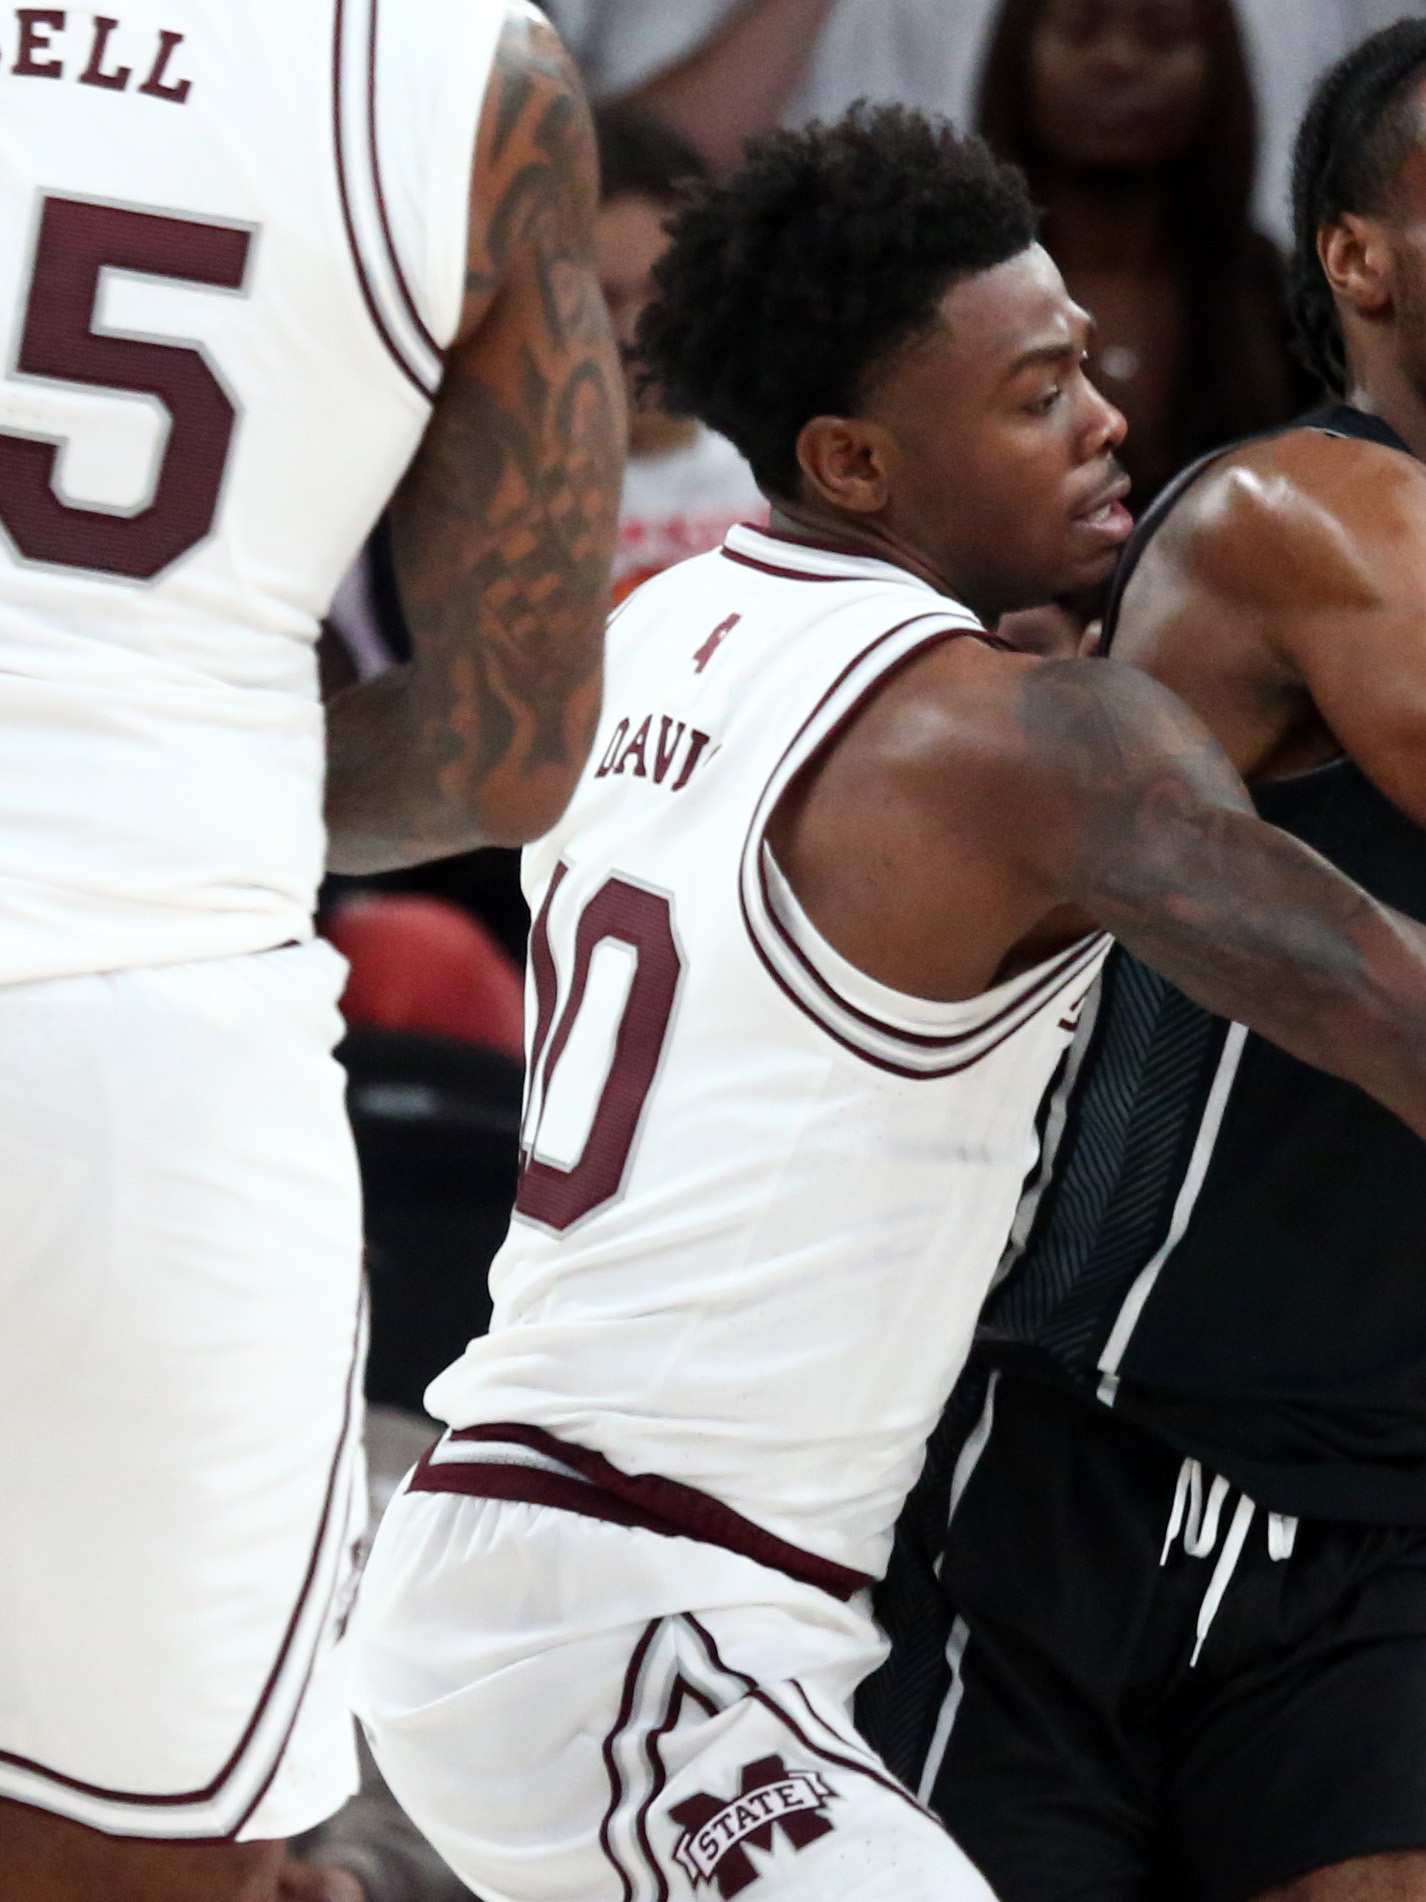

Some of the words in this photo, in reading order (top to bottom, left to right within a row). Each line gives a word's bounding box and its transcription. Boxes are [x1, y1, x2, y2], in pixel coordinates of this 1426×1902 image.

[0, 8, 193, 104] ELL
[0, 186, 261, 590] 5
[698, 1783, 805, 1862] STATE
